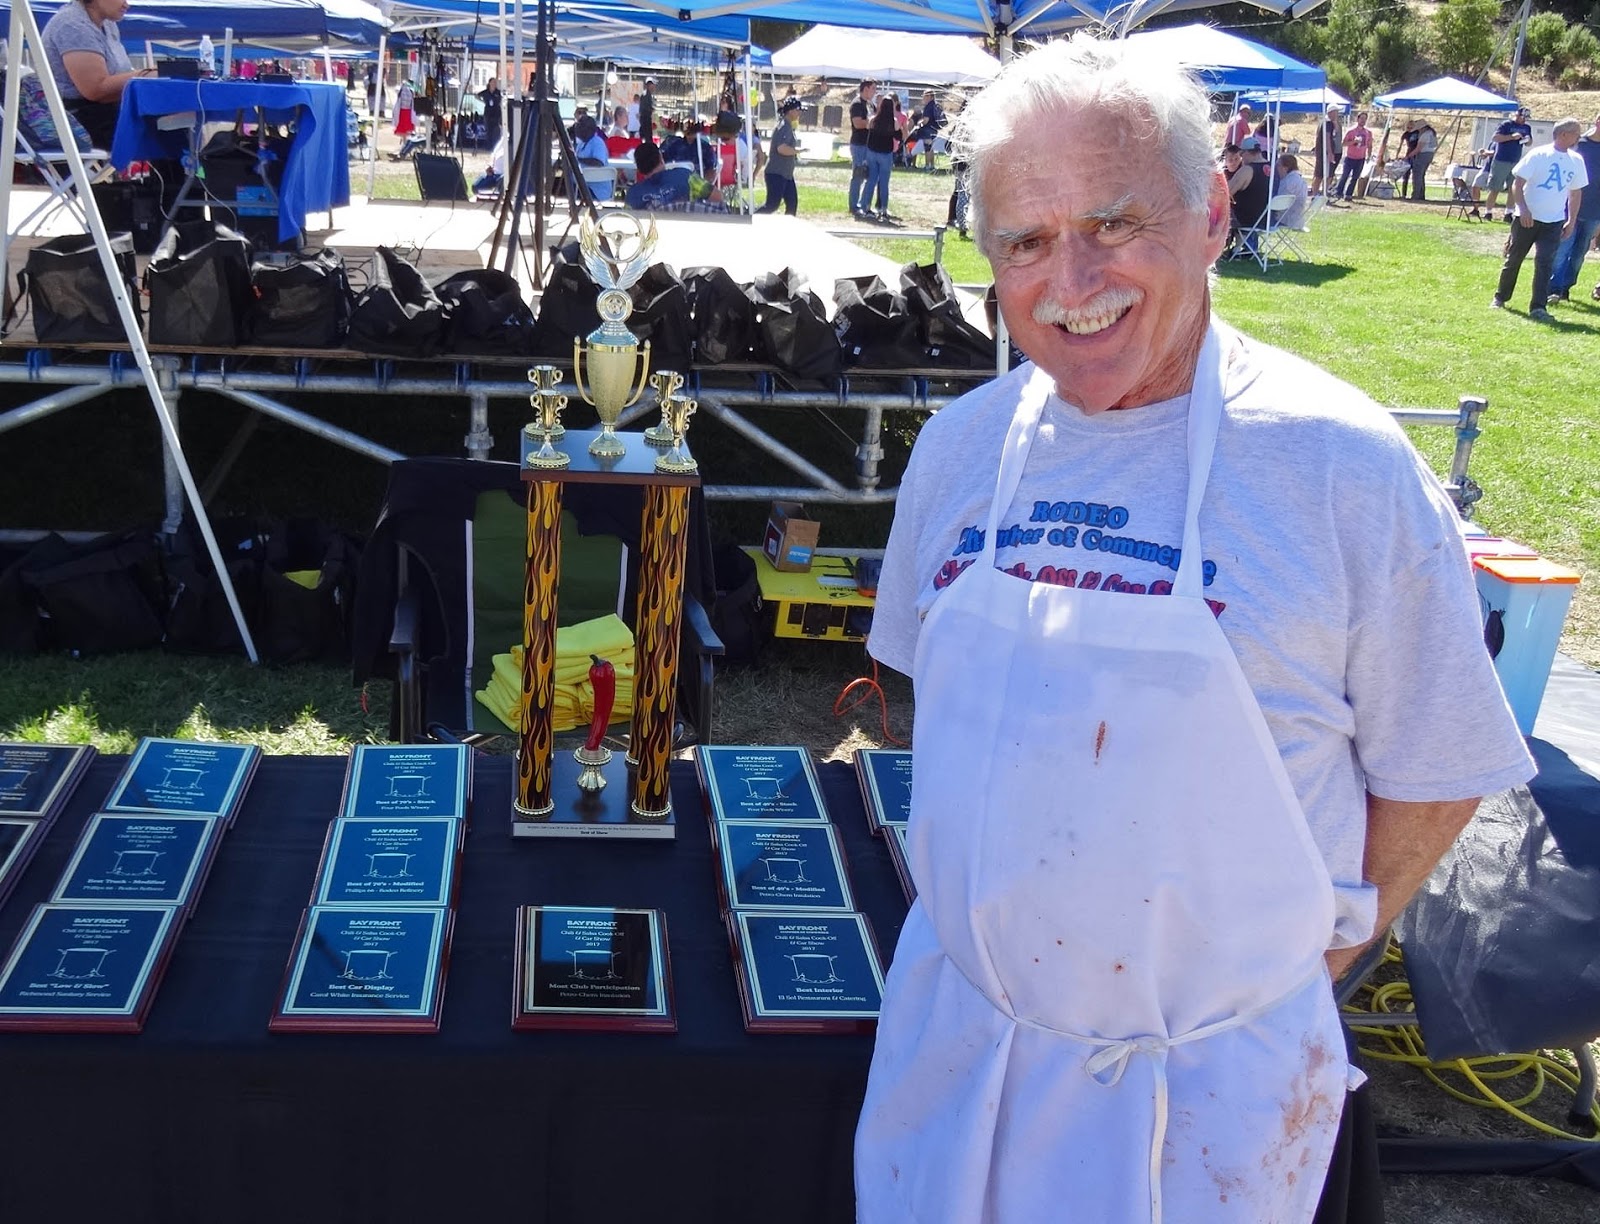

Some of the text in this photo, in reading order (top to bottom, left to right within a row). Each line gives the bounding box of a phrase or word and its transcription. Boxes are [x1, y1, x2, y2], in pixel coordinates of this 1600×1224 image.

[1536, 162, 1574, 192] A's
[1029, 501, 1129, 529] RODEO
[952, 524, 1217, 586] Chmber of Commere
